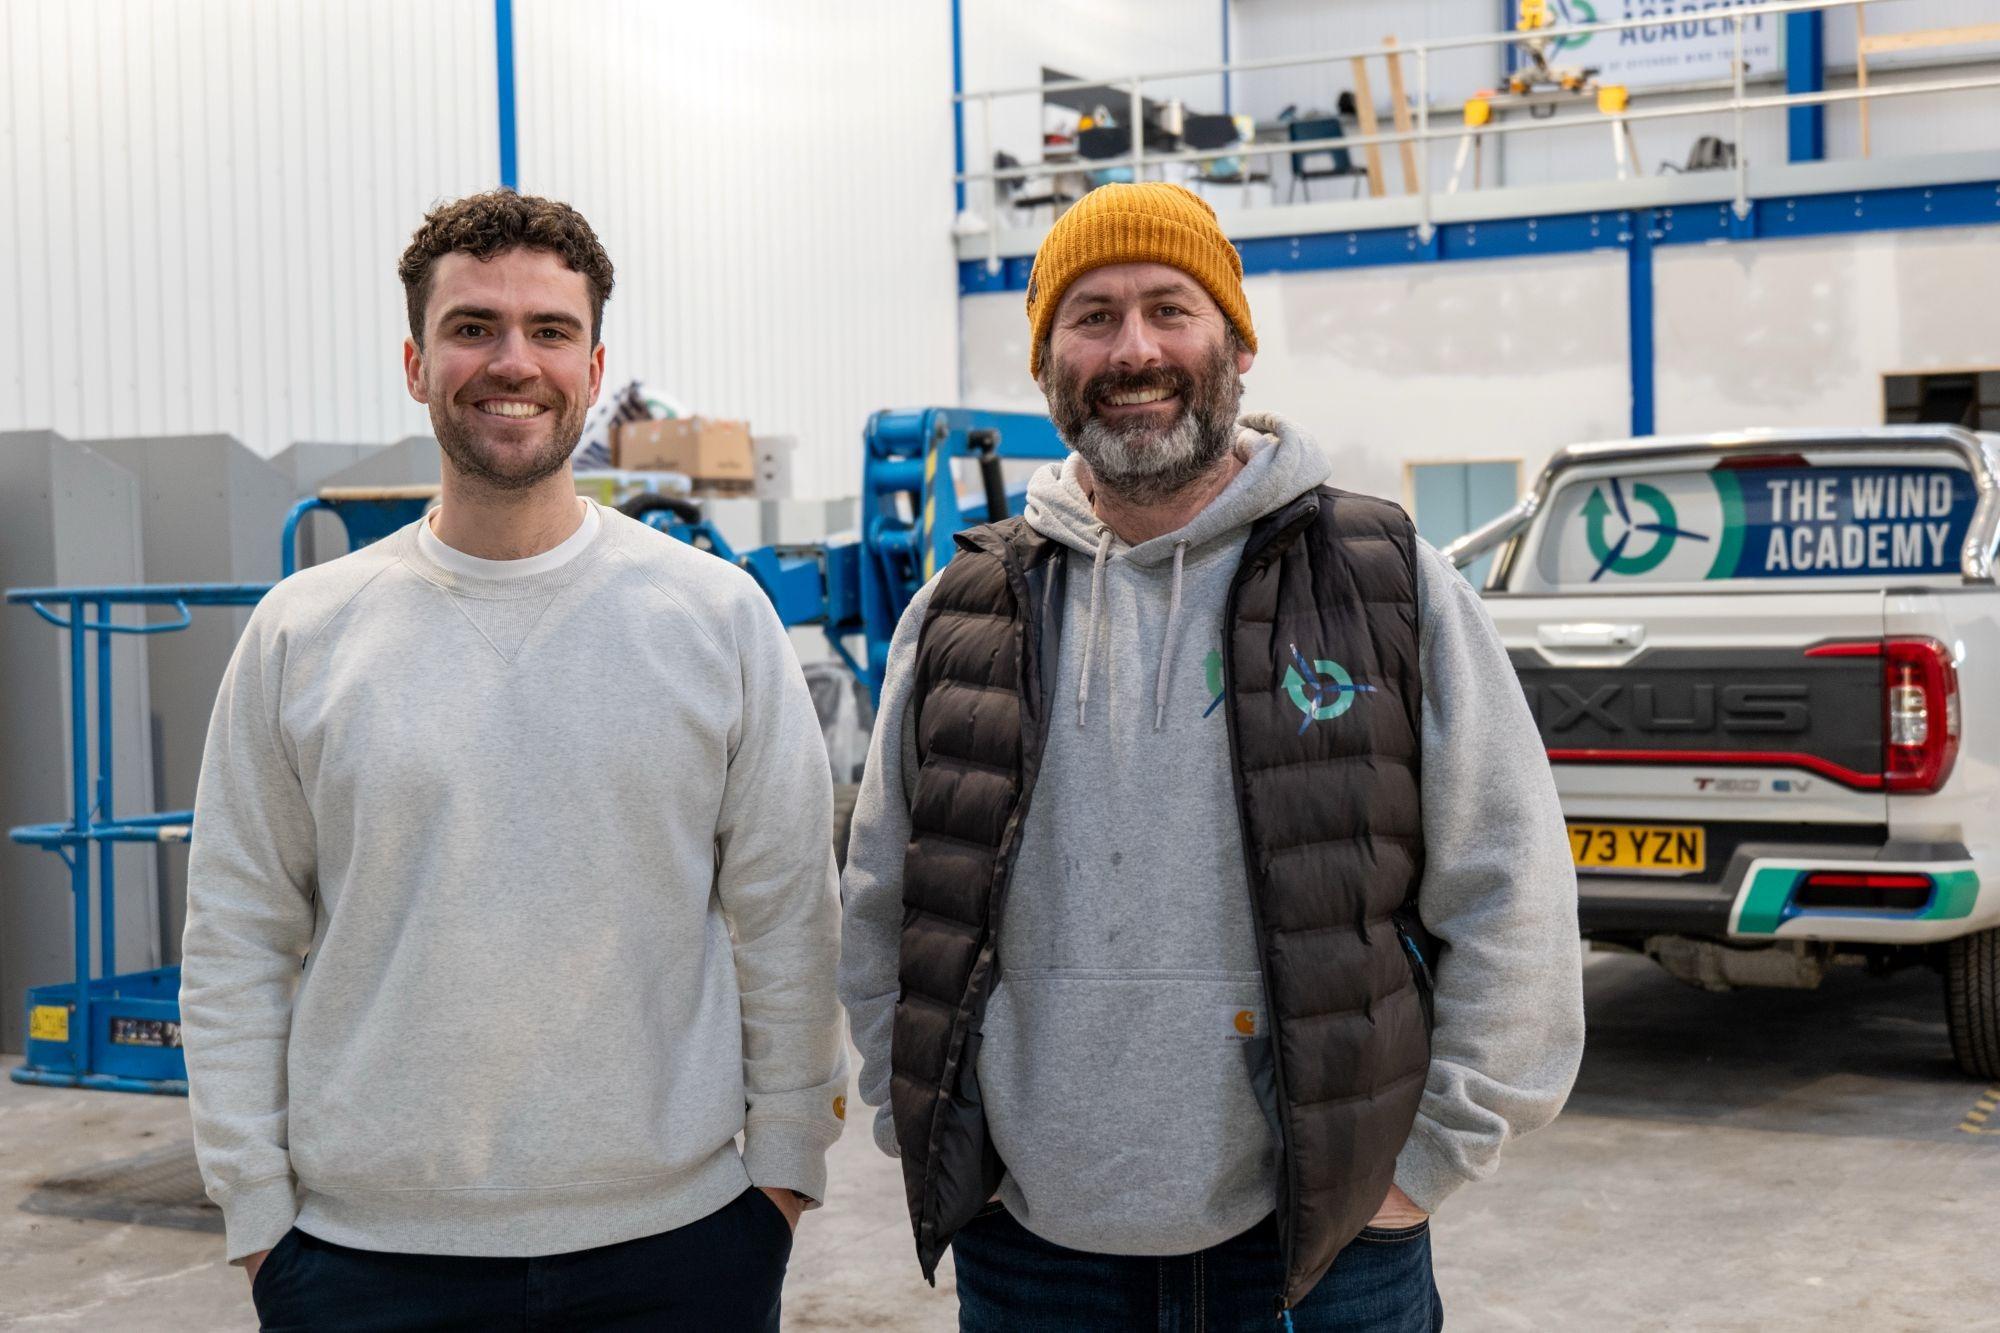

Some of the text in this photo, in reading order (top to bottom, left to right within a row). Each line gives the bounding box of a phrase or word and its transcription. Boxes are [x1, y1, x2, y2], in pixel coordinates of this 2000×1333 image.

[1766, 474, 1952, 522] THE WIND
[1764, 521, 1951, 571] ACADEMY
[1524, 684, 1810, 733] XUS
[1567, 828, 1699, 865] 73 YZN
